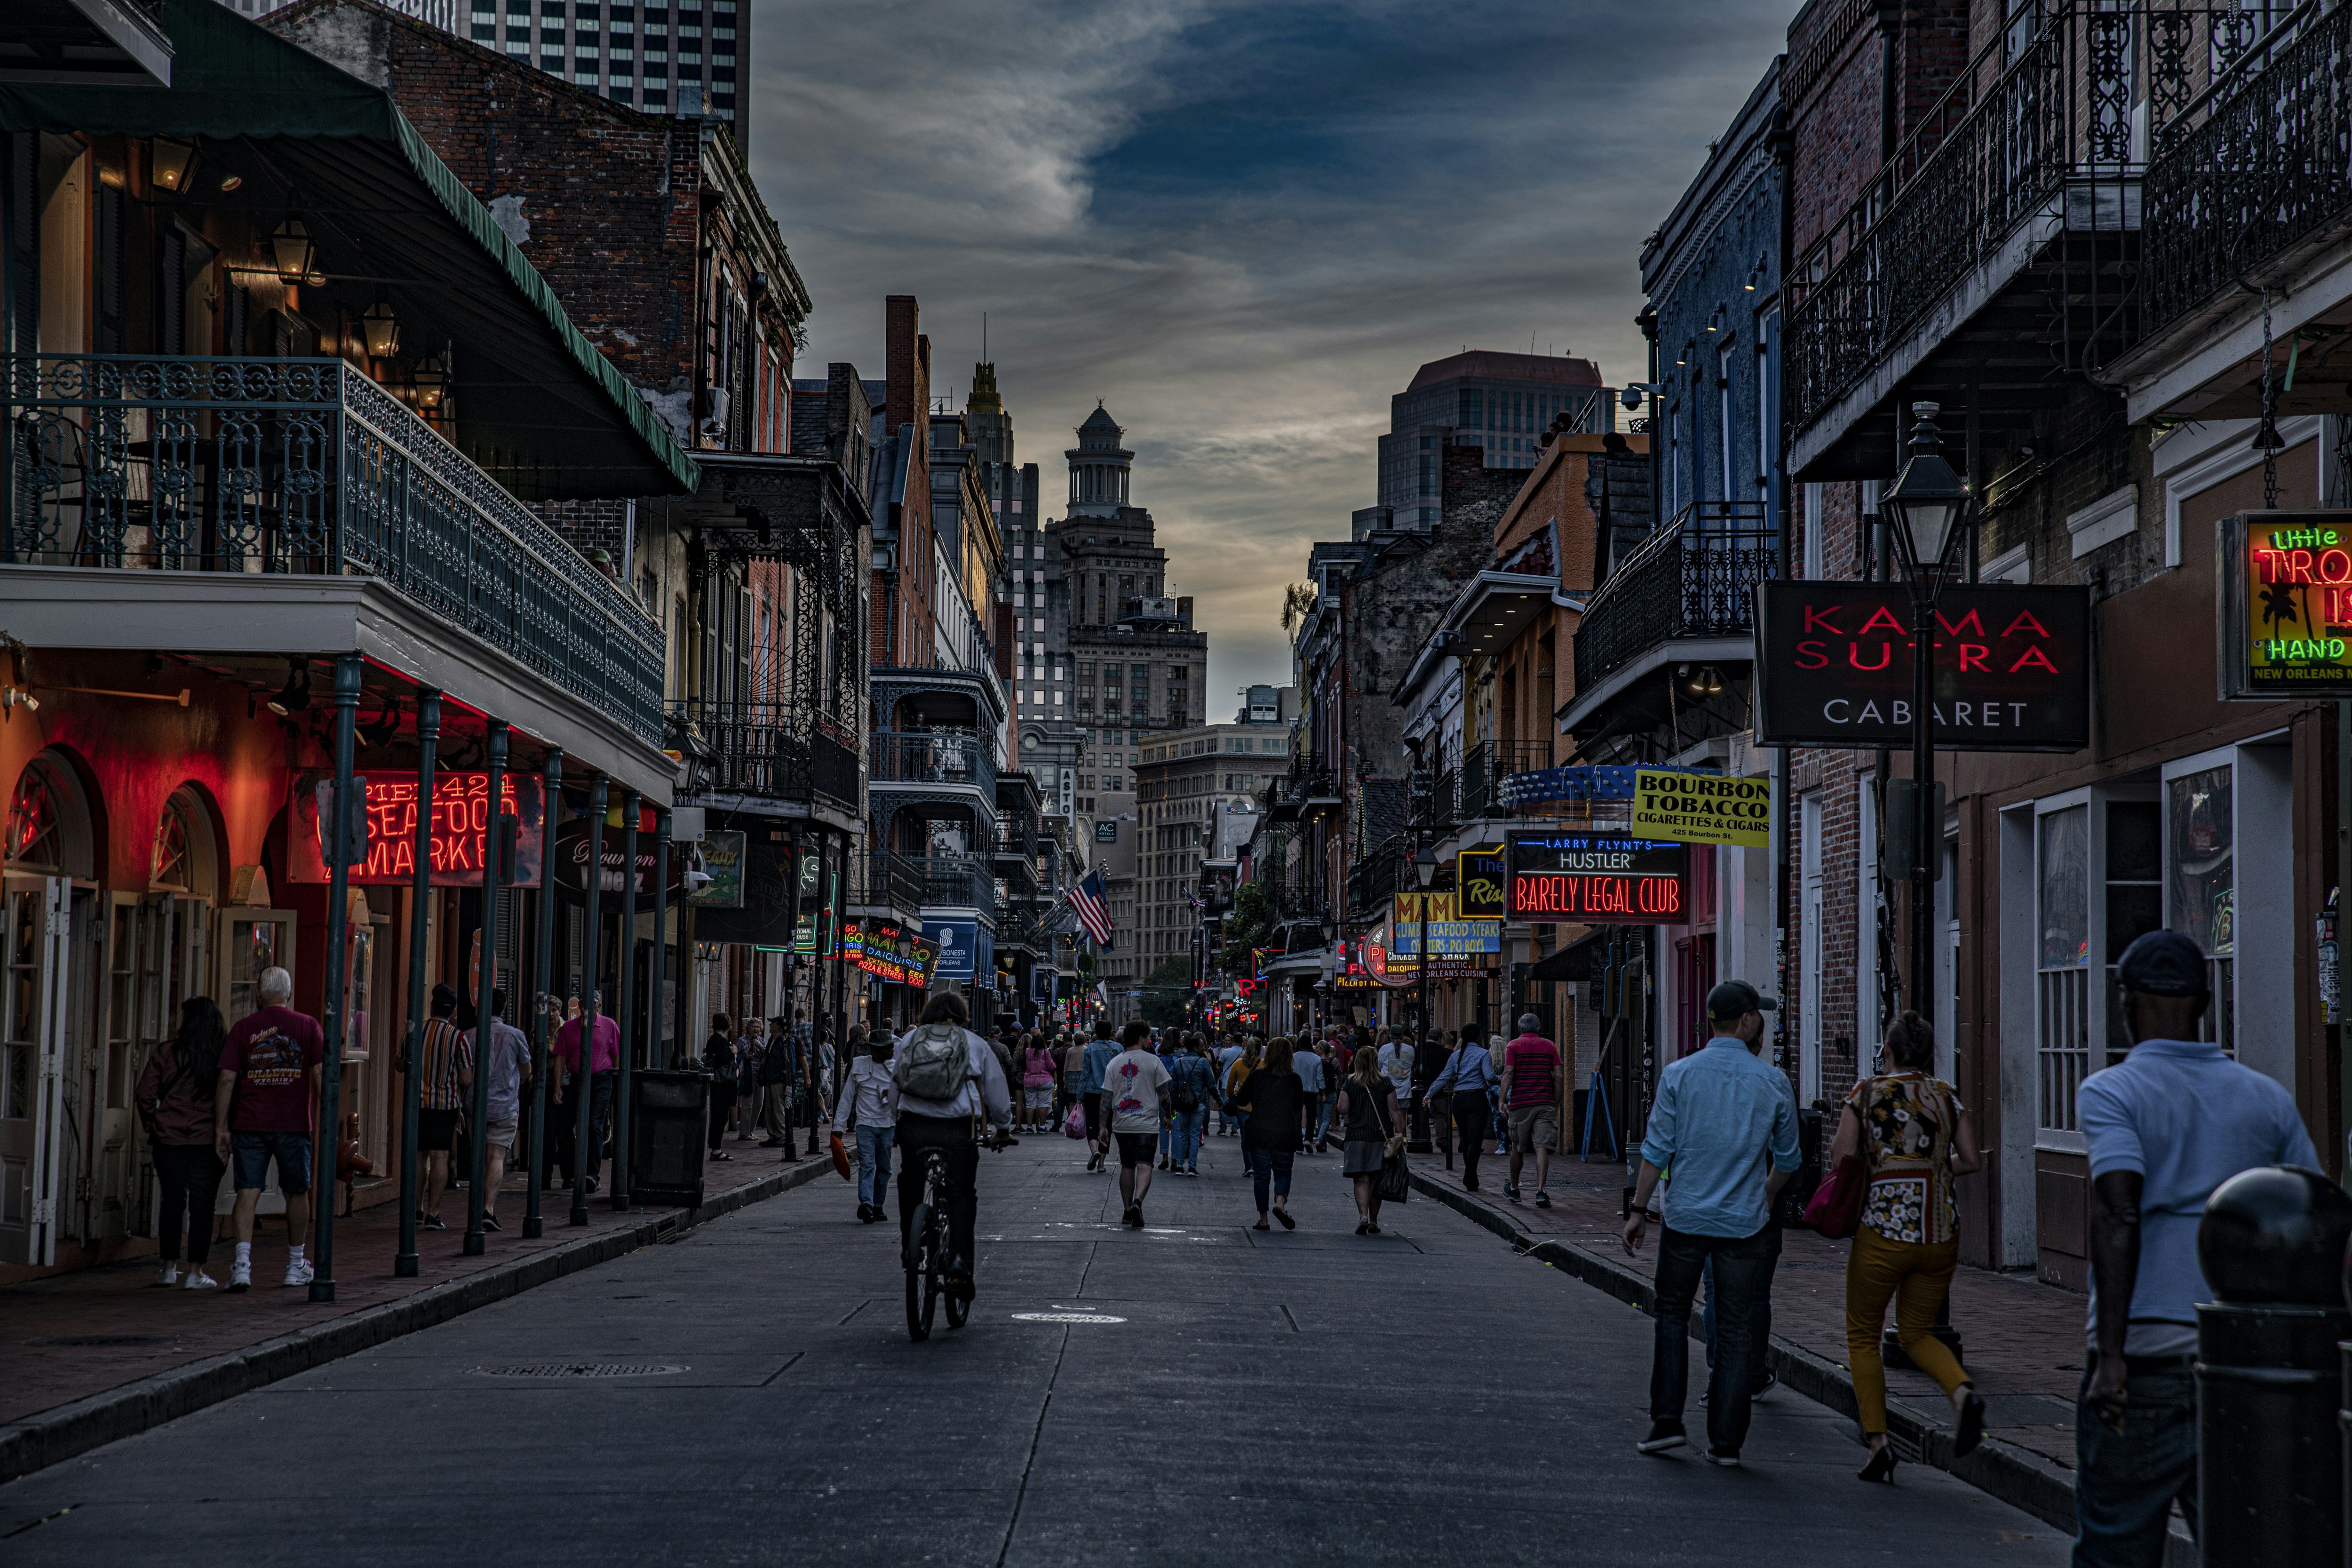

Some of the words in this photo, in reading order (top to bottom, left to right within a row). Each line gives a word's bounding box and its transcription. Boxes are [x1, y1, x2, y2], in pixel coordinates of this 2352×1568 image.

[1804, 605, 2051, 638] KAMA
[1794, 640, 2059, 674] SURA
[2265, 638, 2345, 661] HAND
[2255, 669, 2282, 679] NEW
[2285, 669, 2344, 679] ORLEANS
[1823, 699, 2027, 727] CABARET
[366, 782, 437, 801] PIE
[443, 775, 515, 797] 424
[1640, 775, 1770, 801] BOURBON
[1642, 794, 1768, 819] TOBACCO
[1637, 812, 1711, 828] CIGARETTES
[1714, 818, 1724, 828] &
[1726, 819, 1770, 832] CIGARS
[358, 833, 486, 877] MARKE
[572, 839, 657, 867] Bouron
[1546, 839, 1589, 848] LARRY
[1597, 840, 1652, 851] FLYNT'S
[1474, 858, 1504, 873] The
[580, 866, 644, 892] Vbez
[1516, 876, 1579, 911] BARELY
[1583, 876, 1635, 913] LEGAL
[1638, 877, 1679, 913] CLUB
[1396, 893, 1456, 923] MAM
[1395, 923, 1421, 938] GUMB
[1429, 923, 1469, 938] SEAFOOD
[1470, 923, 1500, 938] STEAKS
[1411, 939, 1445, 953] OYTERS
[865, 956, 892, 970] OCKTAILS
[909, 970, 925, 980] EER
[867, 947, 923, 971] DAIQUIRIS
[1428, 961, 1468, 970] AUTHENTIC
[858, 960, 876, 972] PIZZA
[876, 966, 882, 974] &
[882, 968, 905, 980] STREET
[908, 975, 923, 987] OOD
[1426, 970, 1459, 978] ORLEANS
[247, 1068, 302, 1079] GILLETTE
